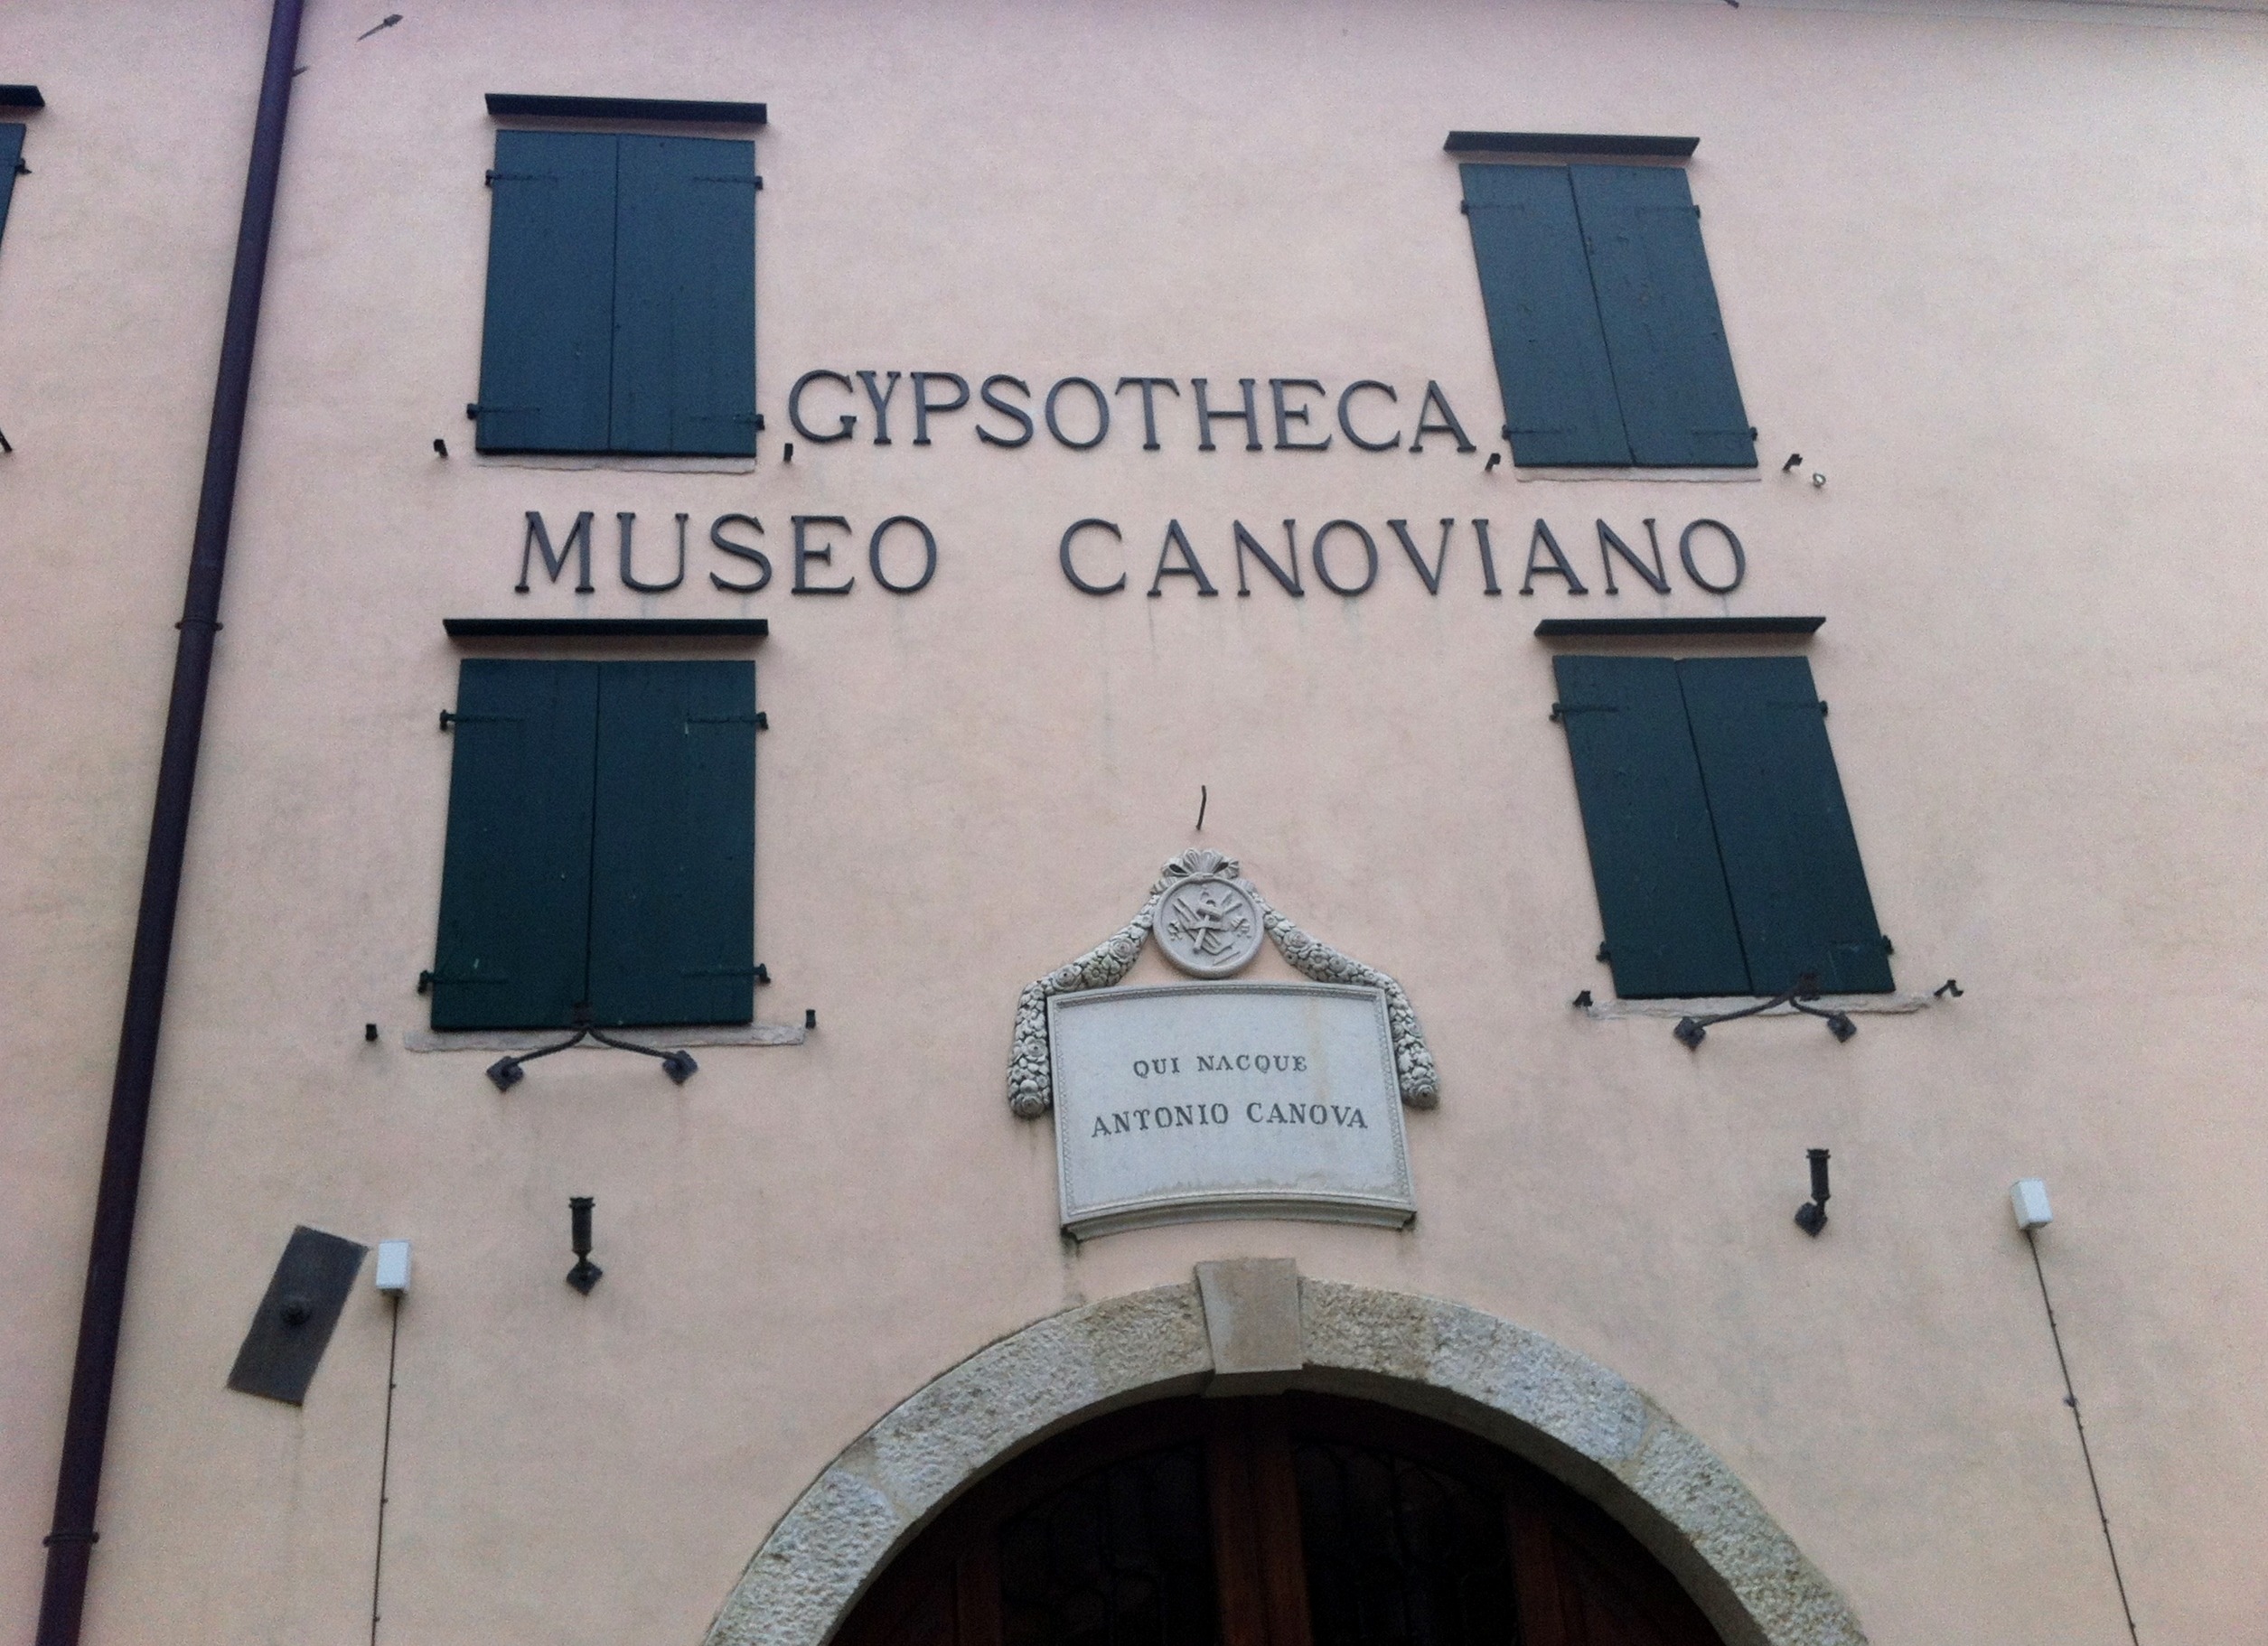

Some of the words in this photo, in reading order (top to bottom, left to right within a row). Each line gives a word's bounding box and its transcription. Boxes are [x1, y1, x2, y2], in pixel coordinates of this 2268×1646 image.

[788, 369, 1476, 454] GYPSOTHECA
[515, 510, 939, 596] MUSEO
[1060, 517, 1746, 598] CANOVIANO
[1132, 1055, 1180, 1079] QUI
[1196, 1053, 1307, 1073] NACQUE
[1091, 1102, 1229, 1137] ANTONIO
[1246, 1102, 1368, 1128] CANOVA
